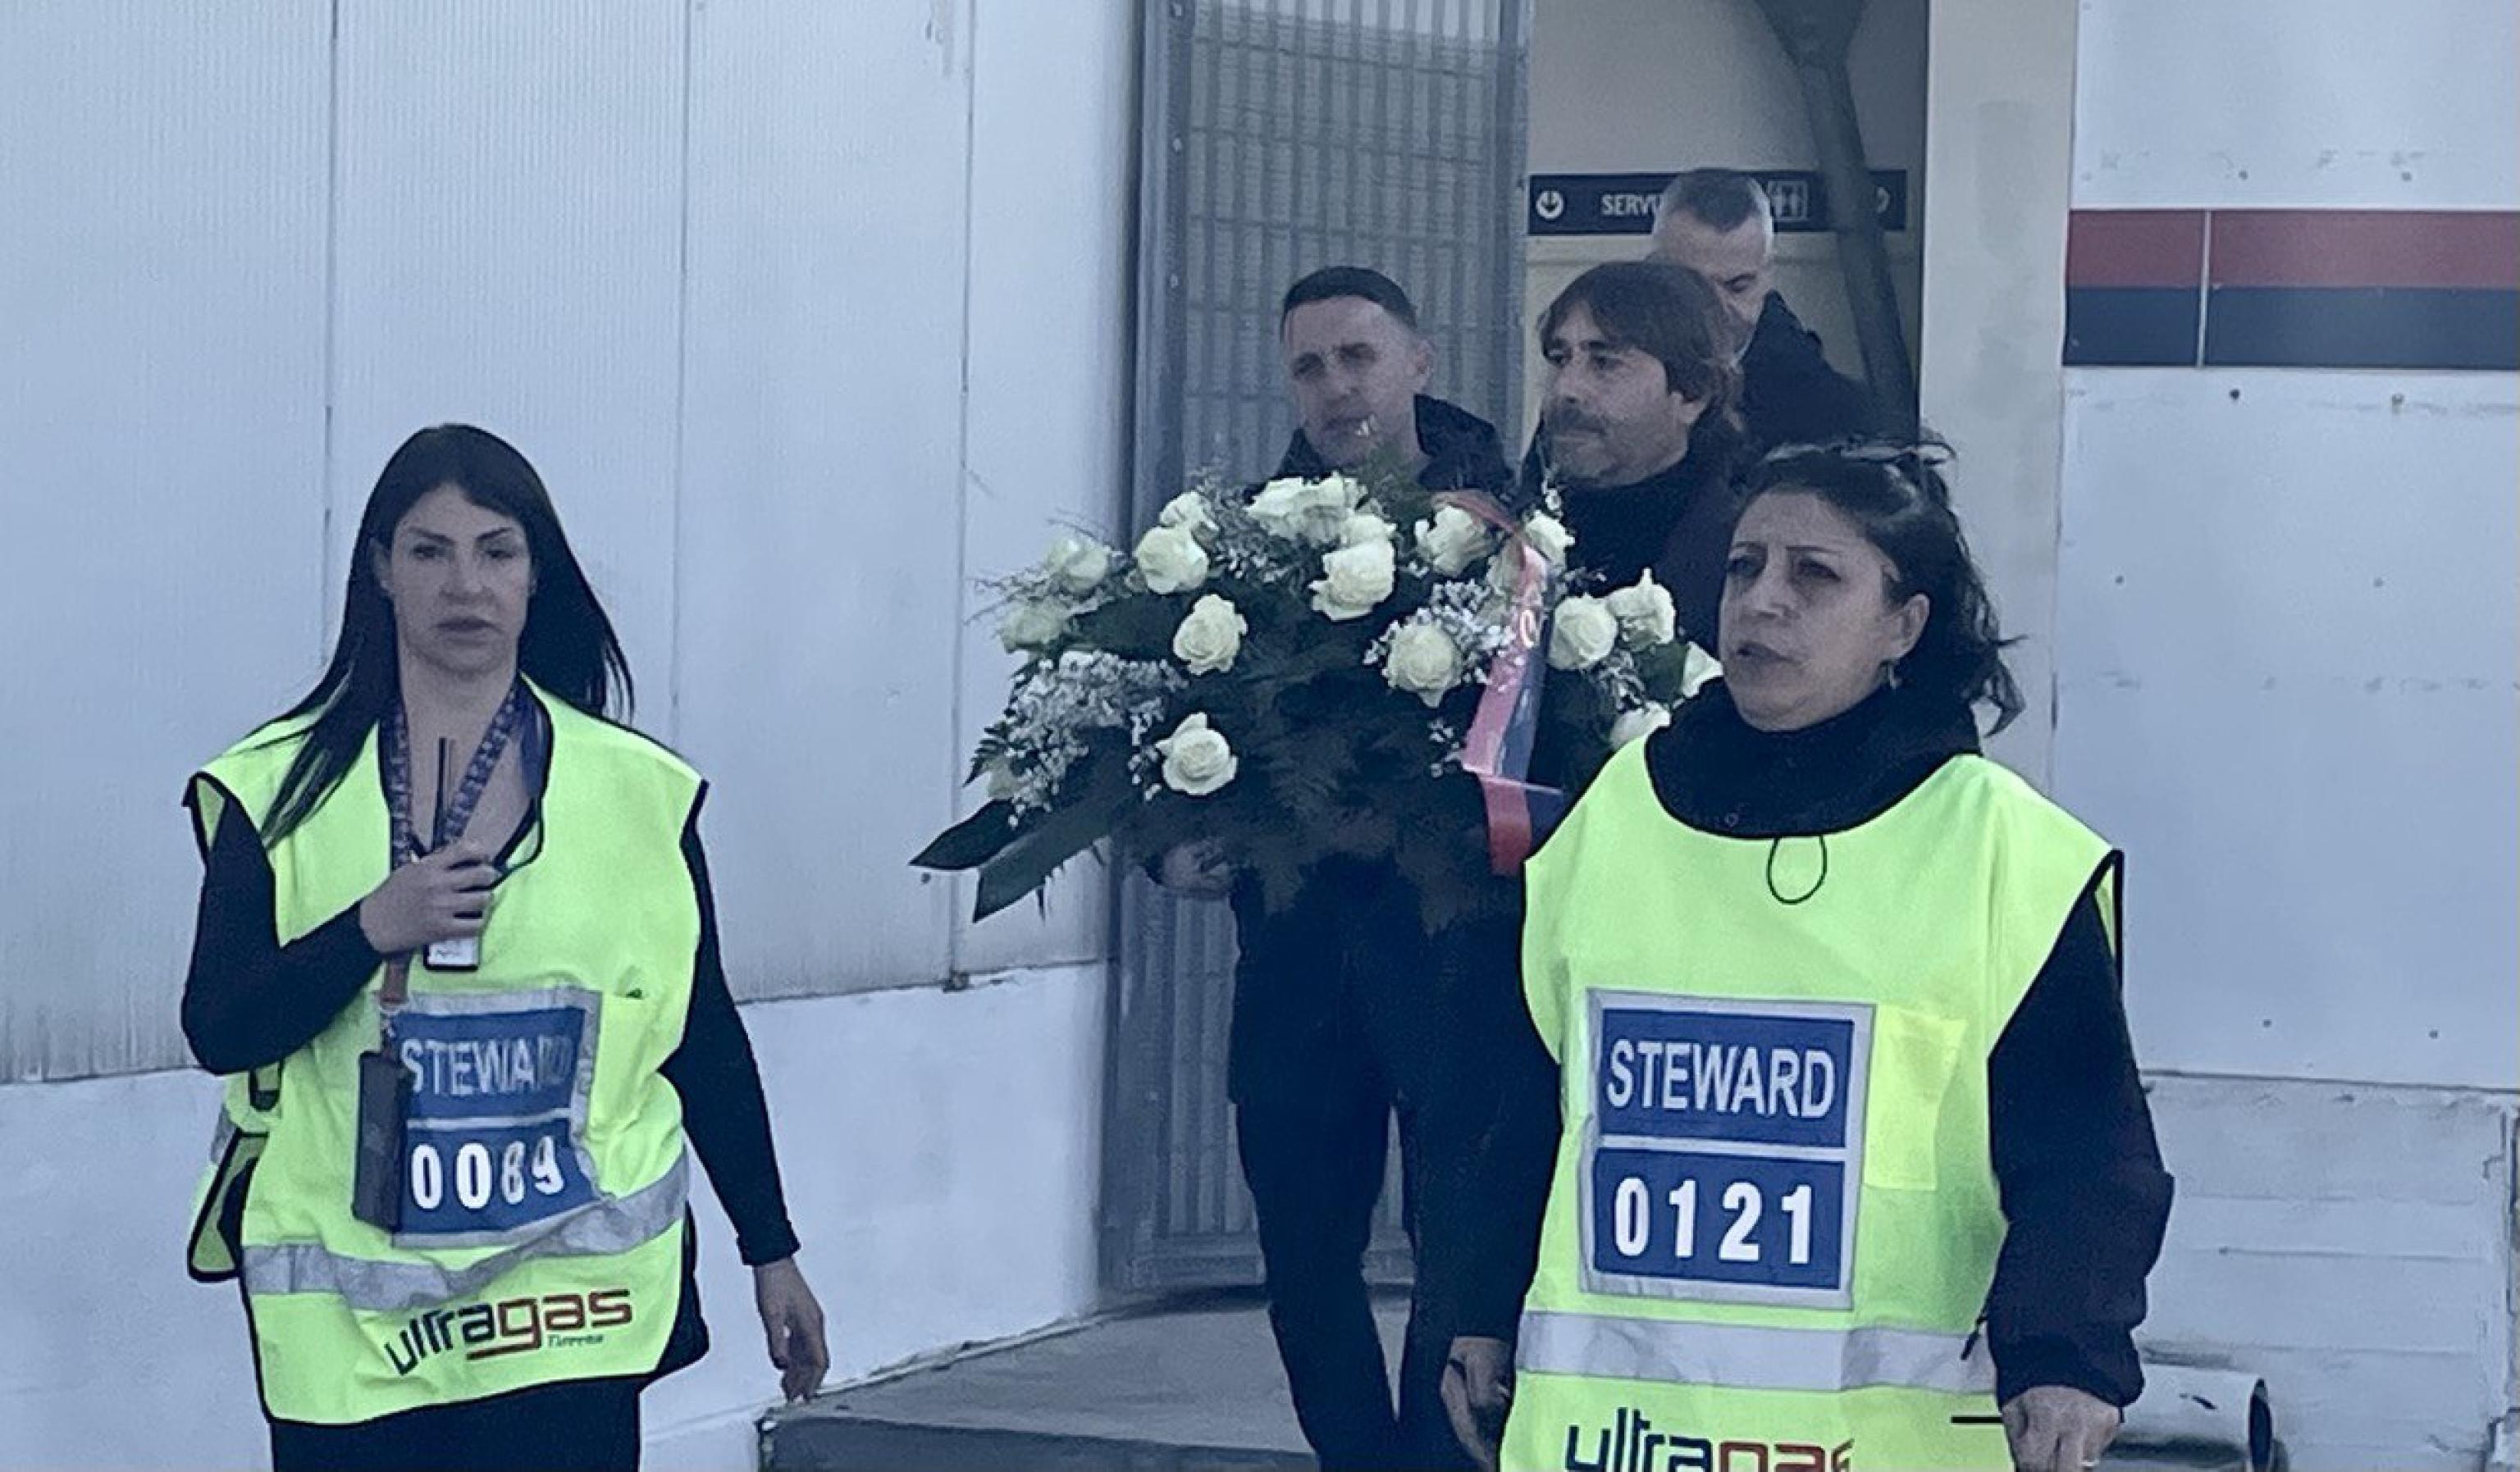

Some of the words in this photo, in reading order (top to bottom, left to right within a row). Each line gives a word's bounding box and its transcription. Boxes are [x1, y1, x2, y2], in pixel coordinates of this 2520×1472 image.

[1605, 1038, 1836, 1119] STEWARD
[1614, 1176, 1813, 1265] 0121
[383, 1288, 633, 1376] ultragas
